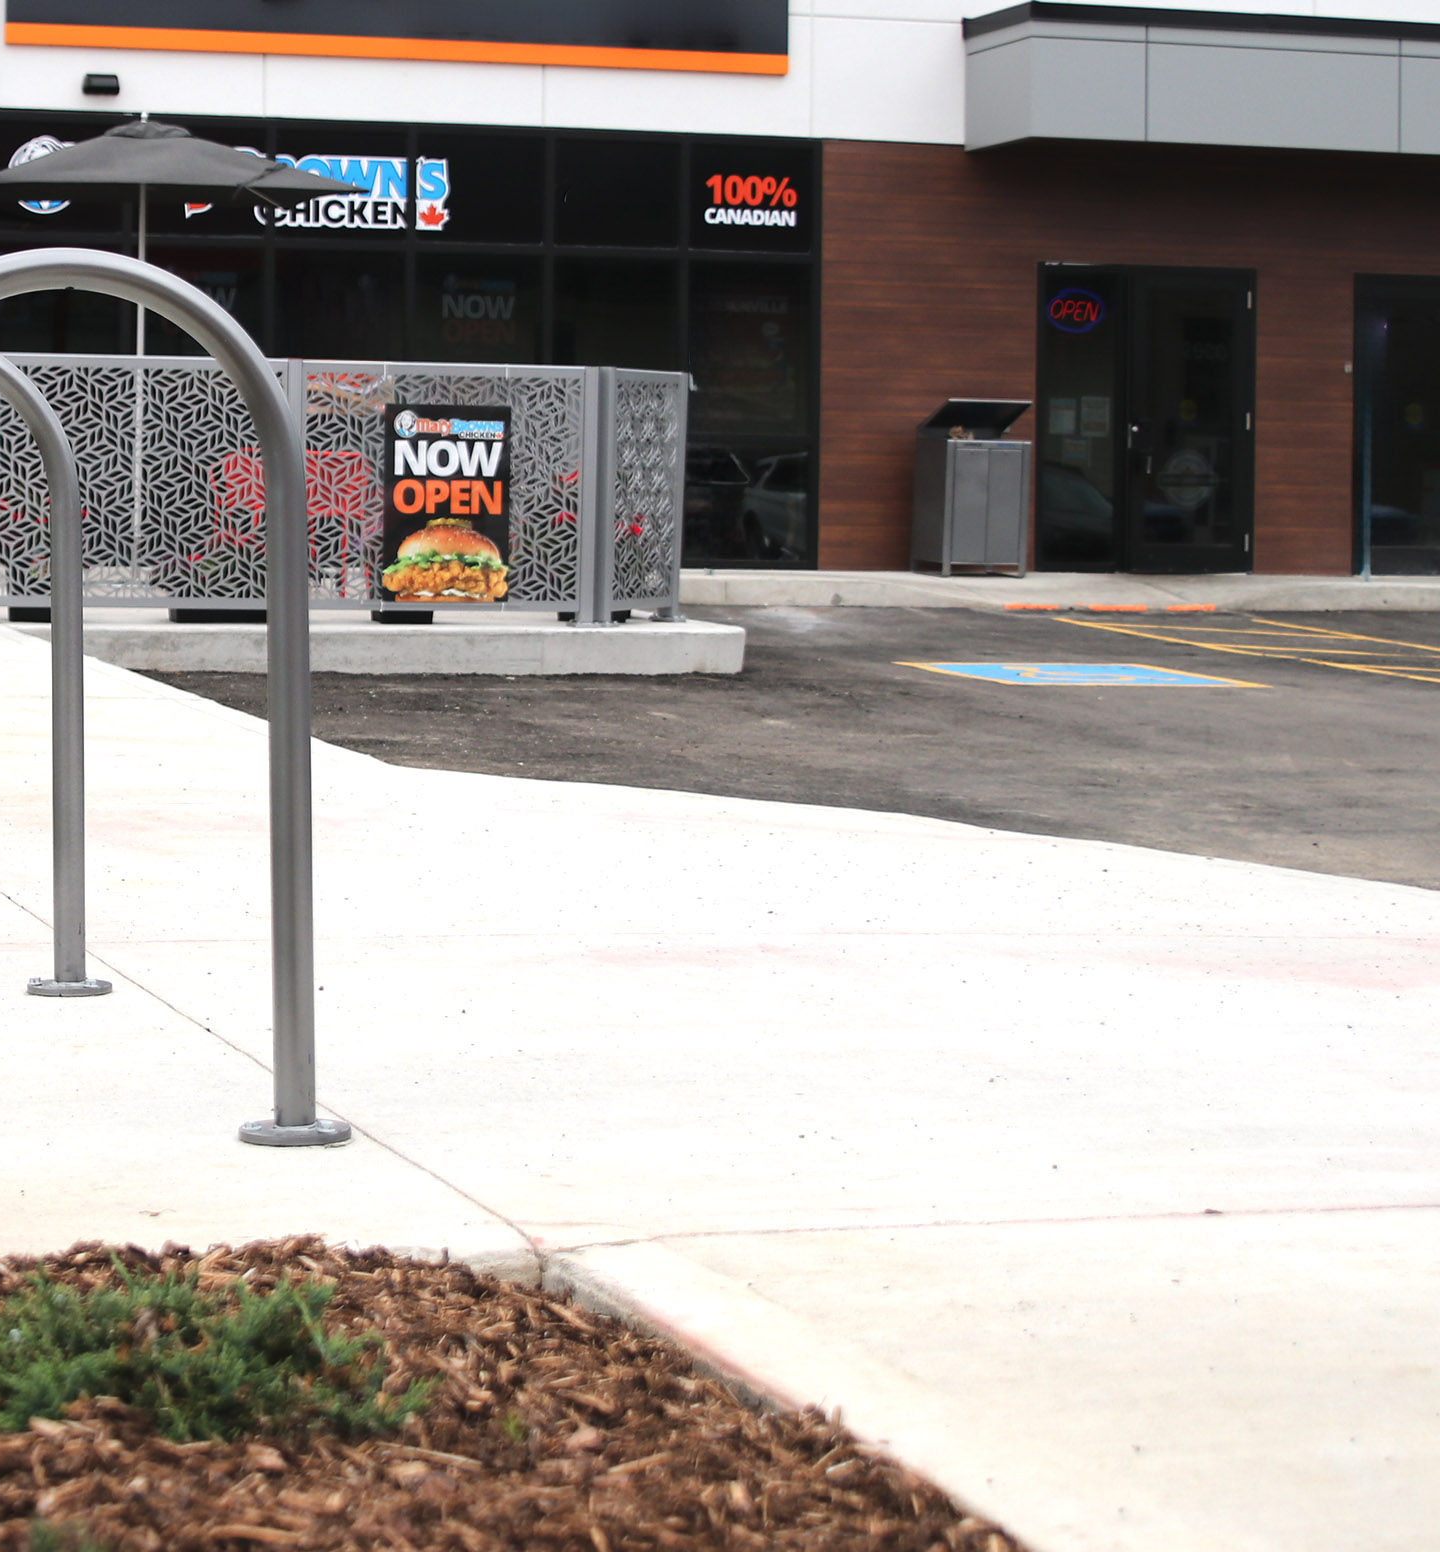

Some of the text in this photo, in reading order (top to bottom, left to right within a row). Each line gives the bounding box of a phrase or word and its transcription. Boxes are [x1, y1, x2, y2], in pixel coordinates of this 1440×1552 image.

[706, 174, 798, 207] 100%
[704, 208, 797, 227] CANADIAN
[441, 293, 516, 321] NOW
[1050, 299, 1100, 322] OPEN
[442, 319, 518, 344] OPEN
[459, 431, 496, 439] CHICKEN
[394, 440, 503, 477] NOW
[393, 479, 503, 515] OPEN
